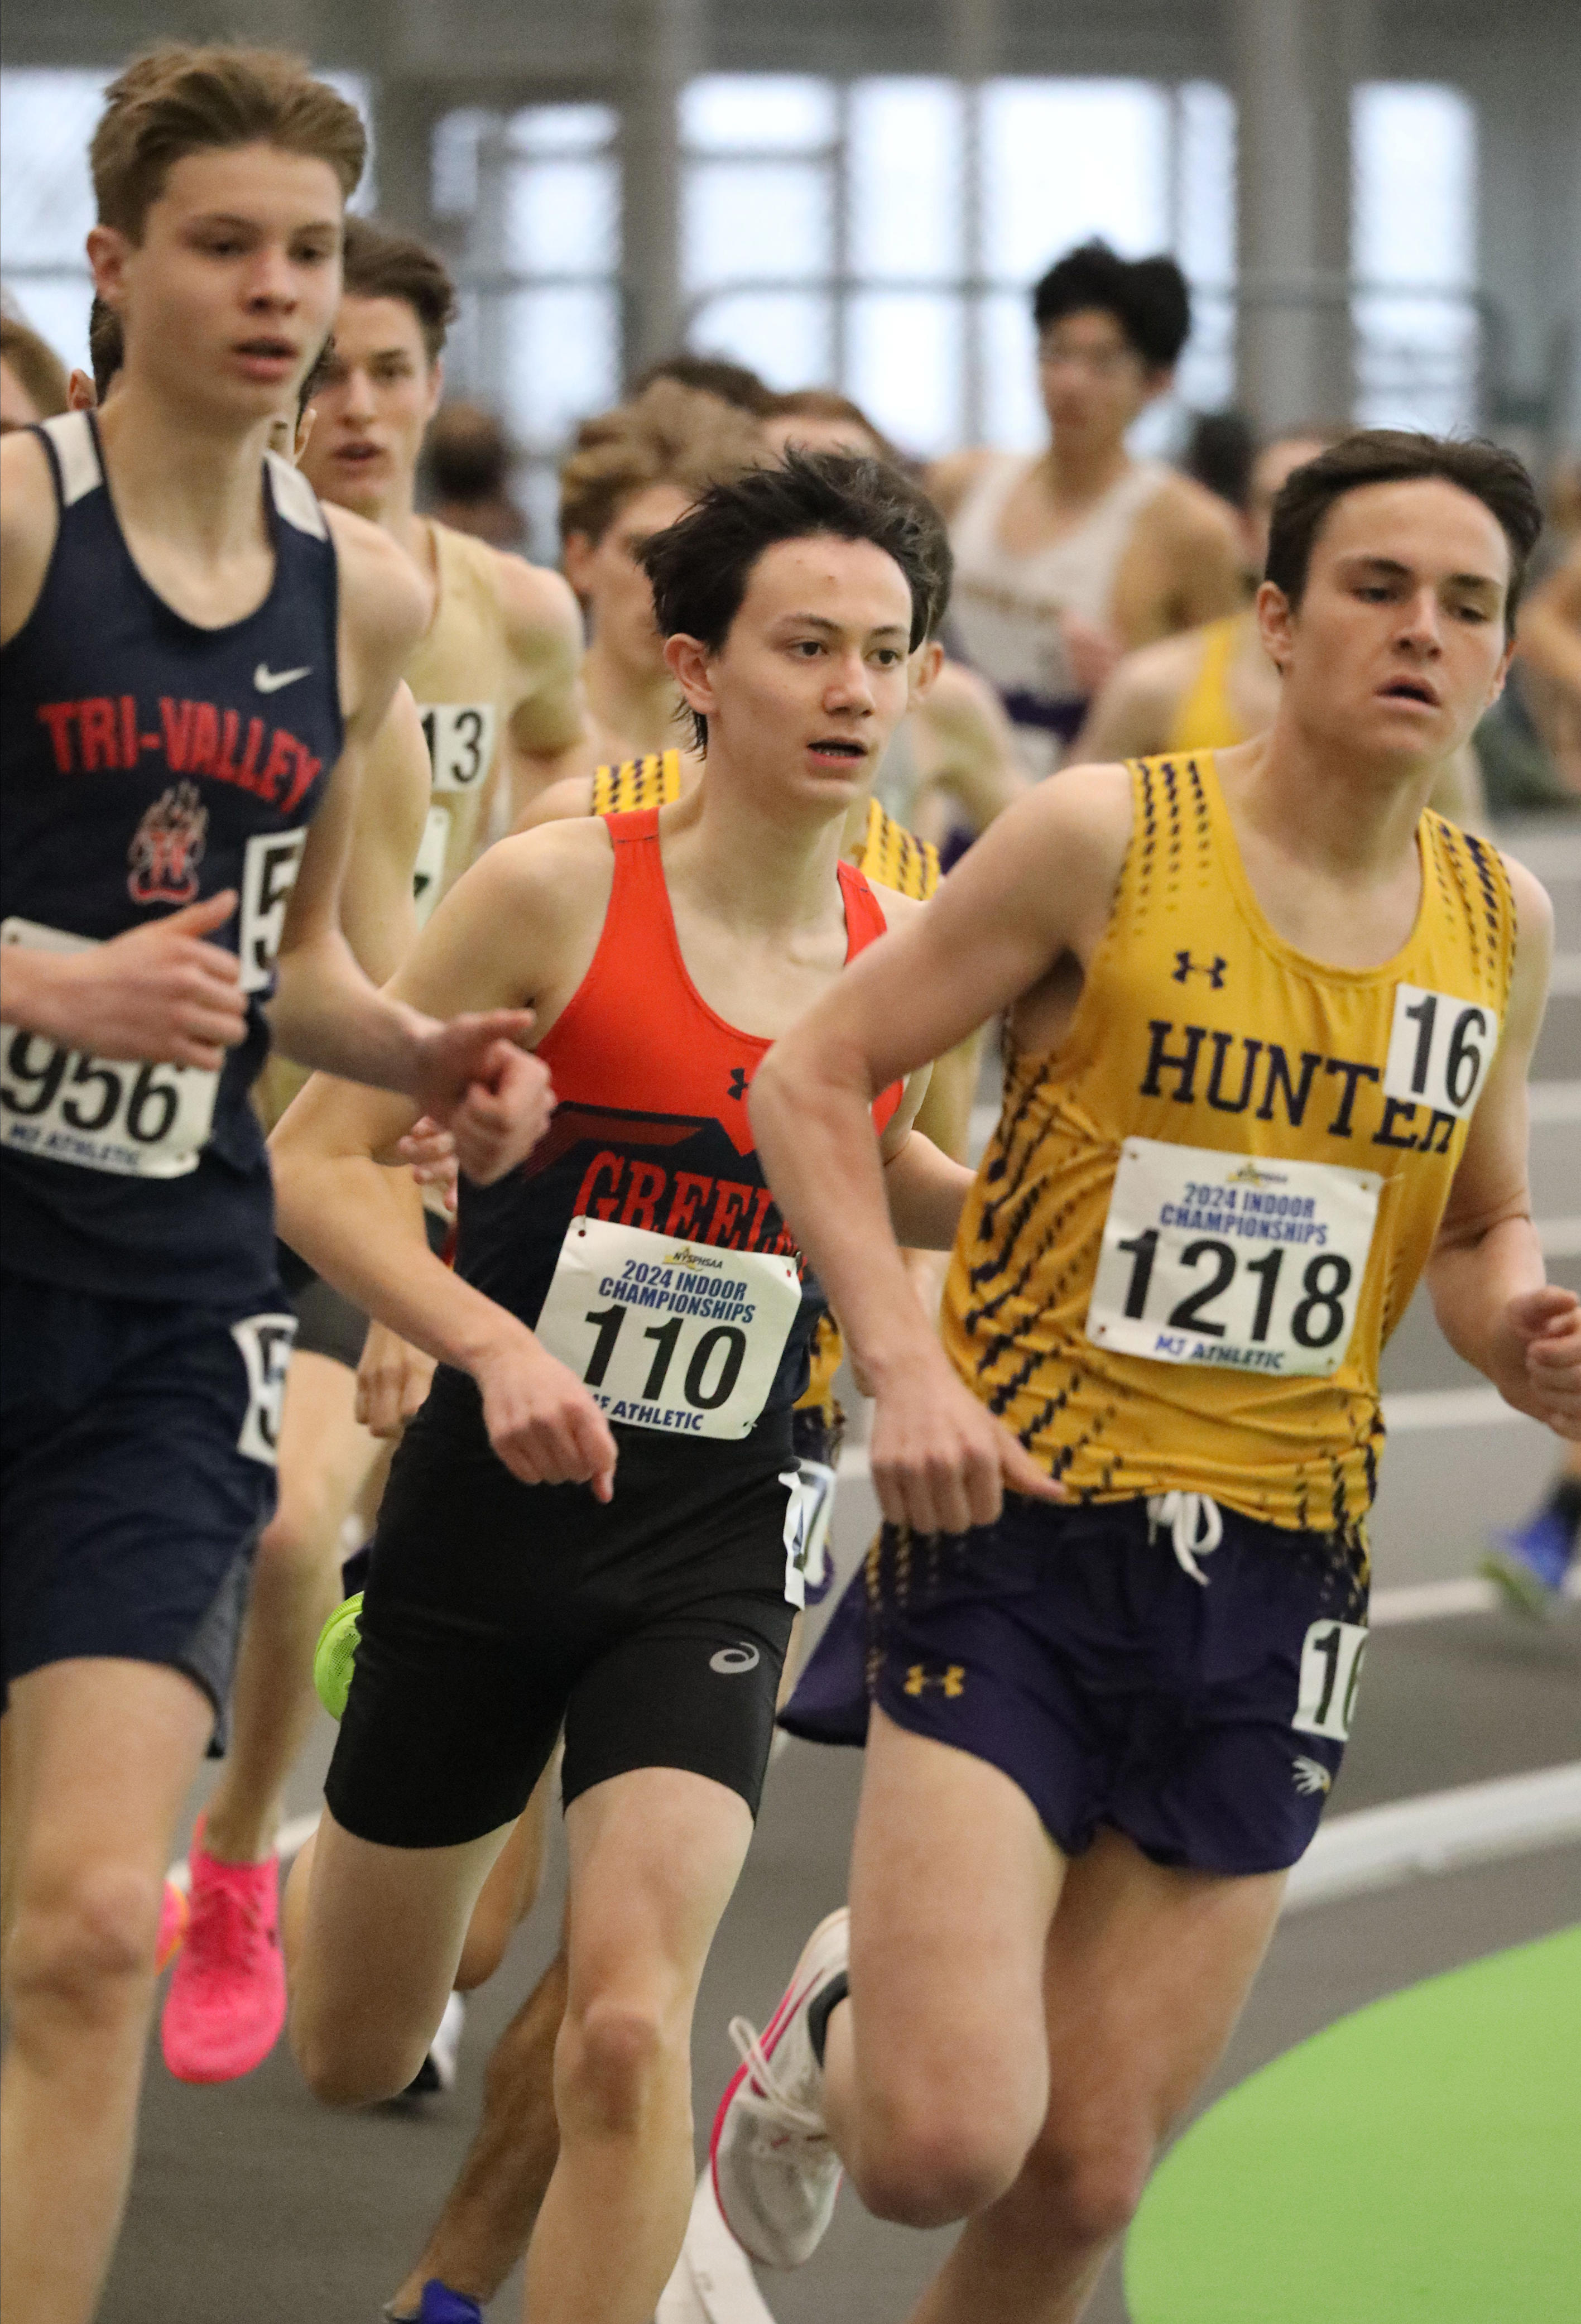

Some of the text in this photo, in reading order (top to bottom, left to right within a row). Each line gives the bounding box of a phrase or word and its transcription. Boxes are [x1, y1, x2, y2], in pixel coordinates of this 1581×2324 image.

[36, 694, 322, 815] TRI-VALLEY
[0, 1033, 177, 1143] 956
[1405, 995, 1487, 1109] 16
[571, 1150, 808, 1281] GREEL
[1160, 1201, 1328, 1247] CHAMPIONSHIPS
[1183, 1180, 1317, 1219] 2024 INDOOR
[598, 1277, 756, 1323] CHAMPIONSHIPS
[621, 1259, 748, 1302] 2024 INDOOR
[1117, 1228, 1352, 1348] 1218
[584, 1304, 747, 1410] 110
[612, 1400, 704, 1431] ATHLETIC
